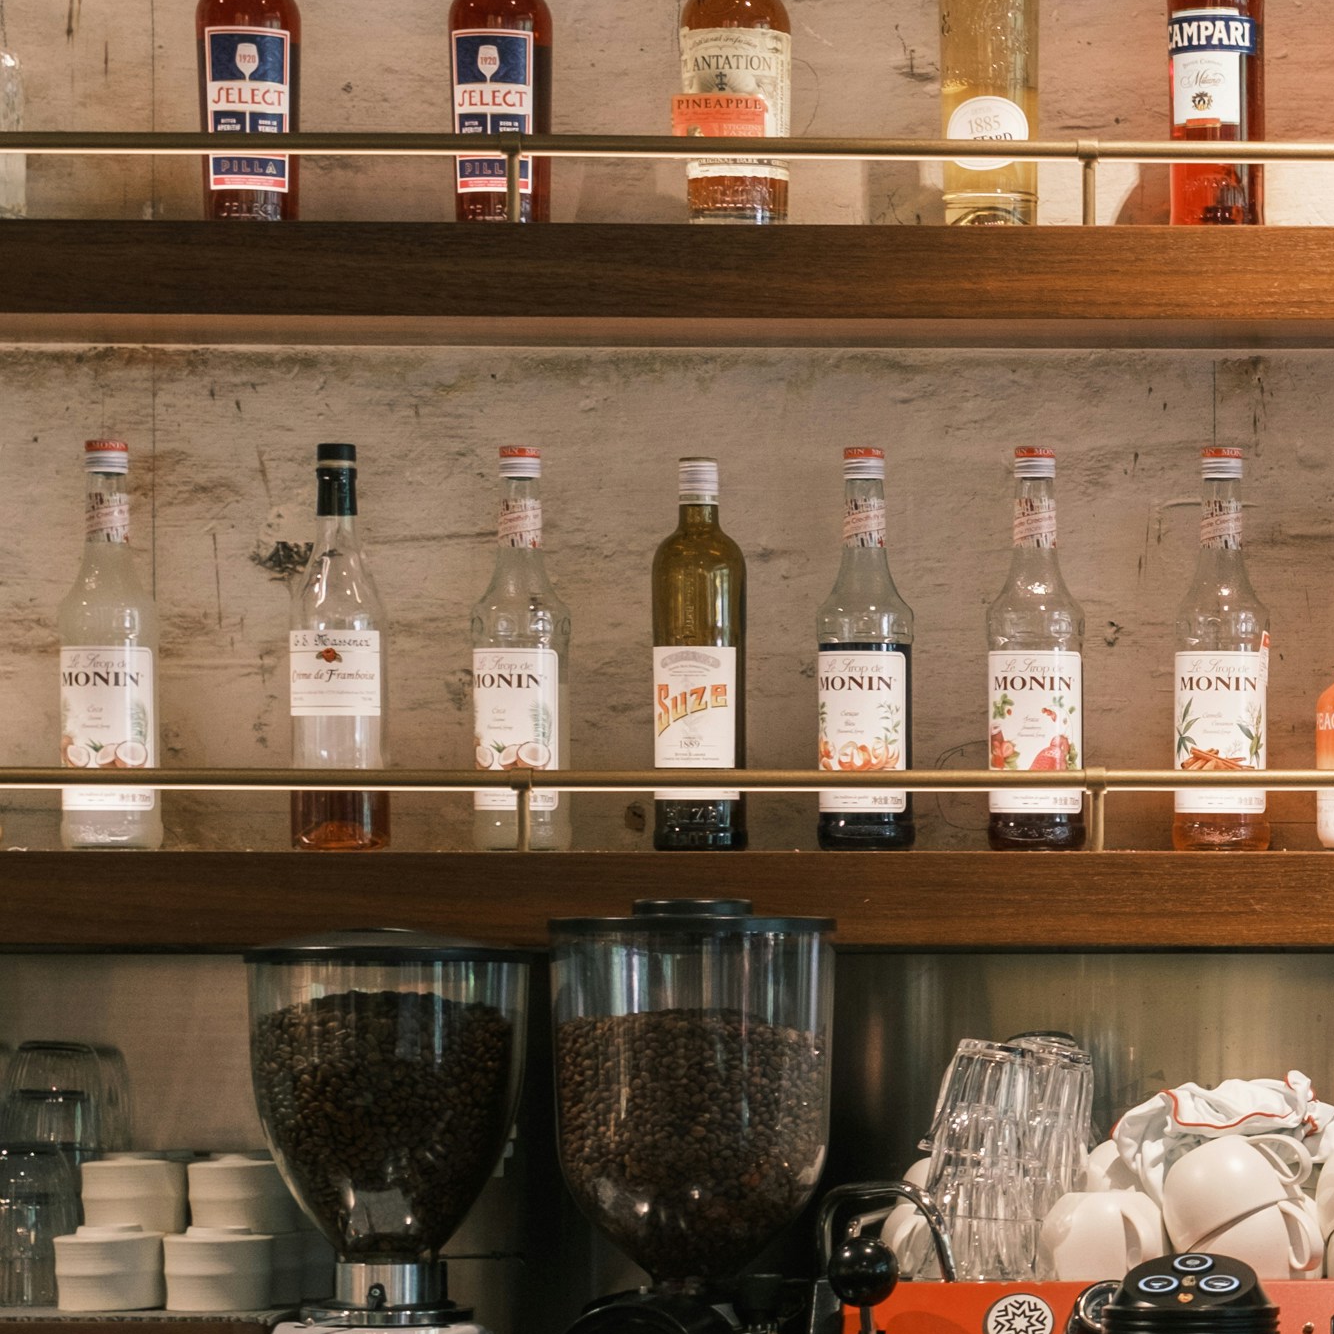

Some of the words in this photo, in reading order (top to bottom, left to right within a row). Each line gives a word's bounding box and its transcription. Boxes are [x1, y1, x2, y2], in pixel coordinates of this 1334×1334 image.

[238, 54, 257, 64] 1920
[480, 56, 497, 66] 1920
[212, 86, 285, 107] SELECT
[458, 89, 527, 108] SELECT
[677, 98, 763, 110] PINEAPPLE
[968, 114, 1001, 135] 1885
[220, 159, 278, 175] PILLA
[463, 162, 505, 175] PILL
[1000, 658, 1016, 673] Le
[1018, 657, 1050, 676] Sirop
[1186, 658, 1201, 673] Le
[1204, 658, 1236, 677] Sirop
[62, 671, 140, 687] MONIN
[314, 669, 324, 680] de
[325, 668, 375, 683] Framboise
[473, 673, 545, 689] MONIN
[819, 675, 893, 691] MONIN
[994, 675, 1072, 691] MONIN
[1180, 676, 1257, 691] MONIN
[657, 683, 728, 737] Suze
[679, 739, 701, 749] 1889
